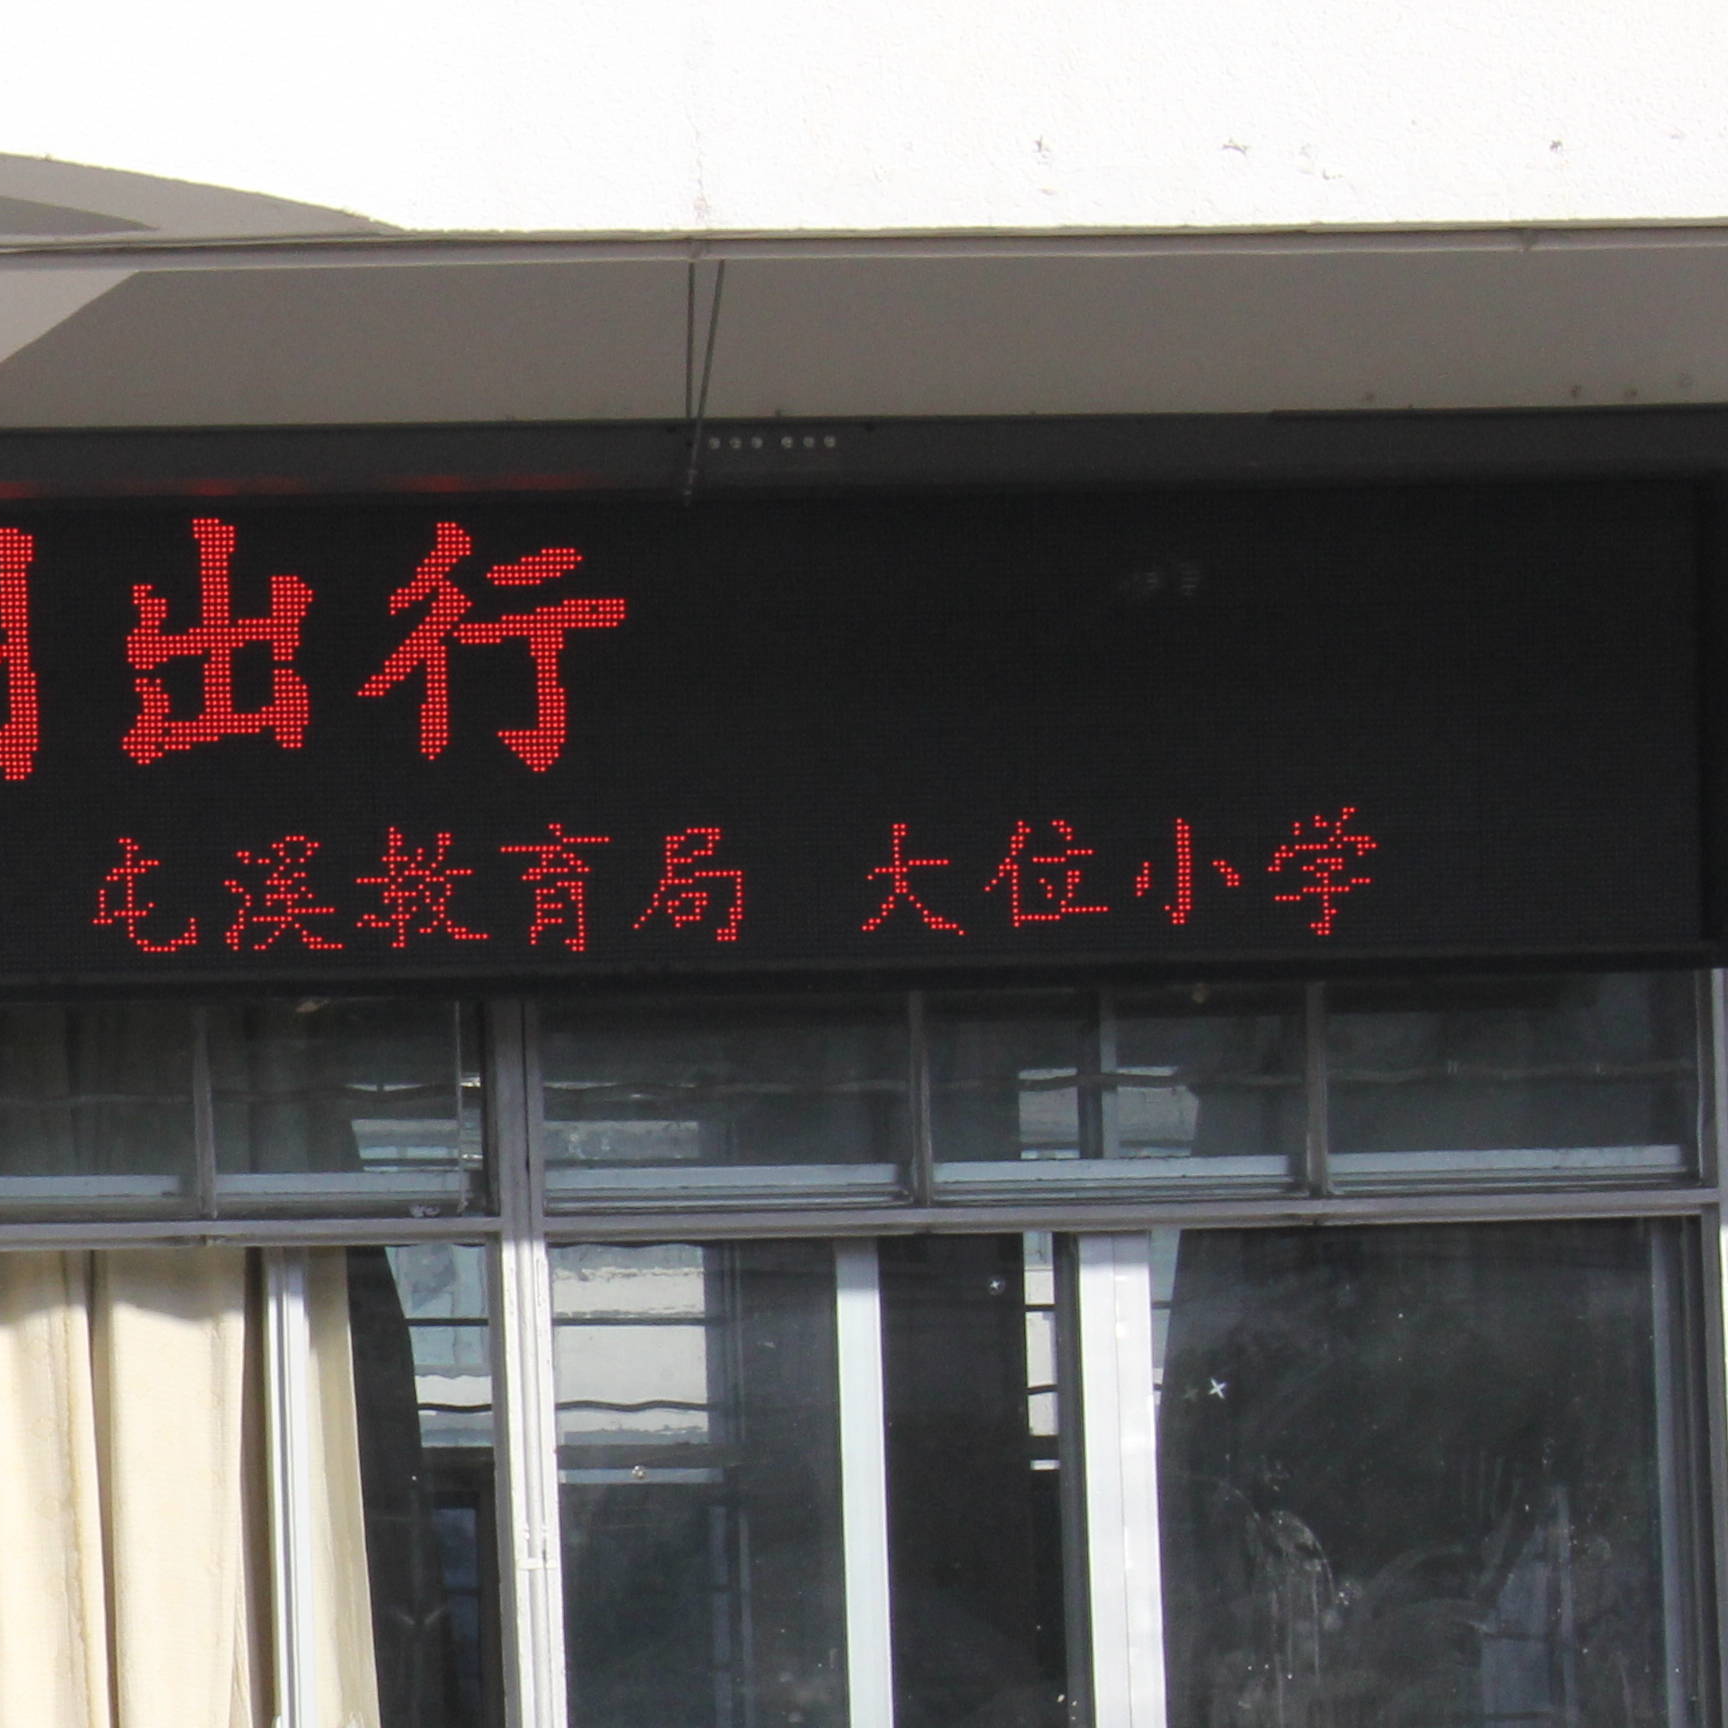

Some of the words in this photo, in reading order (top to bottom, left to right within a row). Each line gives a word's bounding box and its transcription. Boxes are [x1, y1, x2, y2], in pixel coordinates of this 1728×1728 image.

[91, 822, 746, 954] 屯溪教育局
[861, 806, 1379, 937] 大位小学
